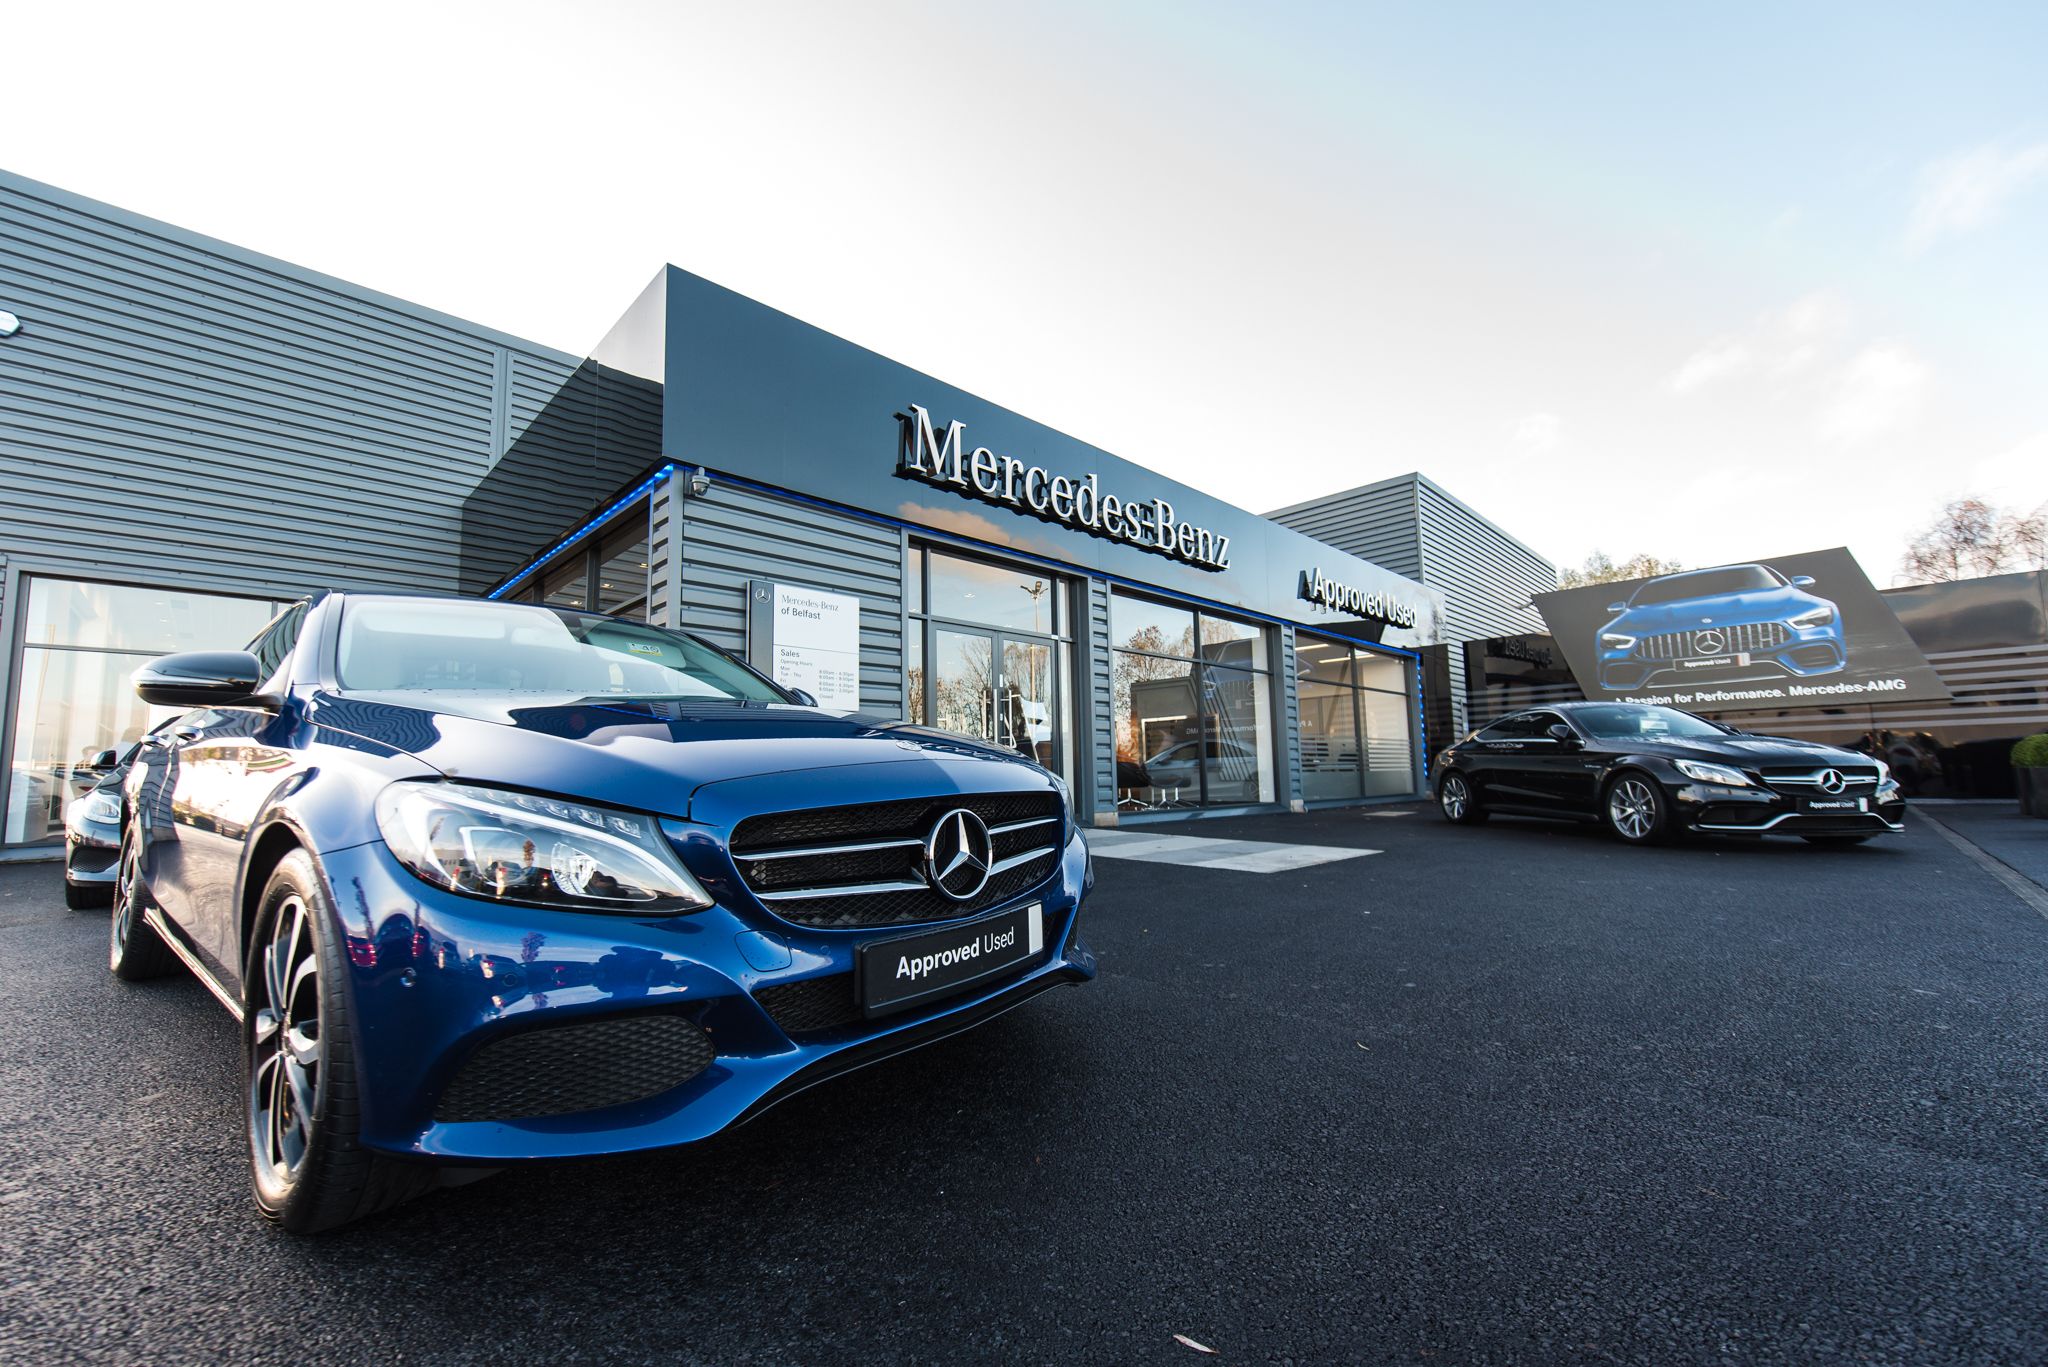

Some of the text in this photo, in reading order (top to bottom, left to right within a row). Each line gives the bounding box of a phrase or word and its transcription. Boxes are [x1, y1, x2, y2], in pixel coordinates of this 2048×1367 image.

[910, 403, 1231, 569] Mercedes-Benz
[781, 594, 839, 612] Mercedes-Benz
[1311, 567, 1418, 628] Approved Used
[781, 606, 821, 620] of Belfast
[780, 649, 800, 658] Sales
[1625, 695, 1672, 705] Passion
[1674, 693, 1693, 704] for
[1695, 688, 1786, 702] Performance.
[1788, 679, 1907, 697] Mercedes-AMG
[1809, 801, 1840, 809] Approved
[895, 926, 1015, 981] Approved Used
